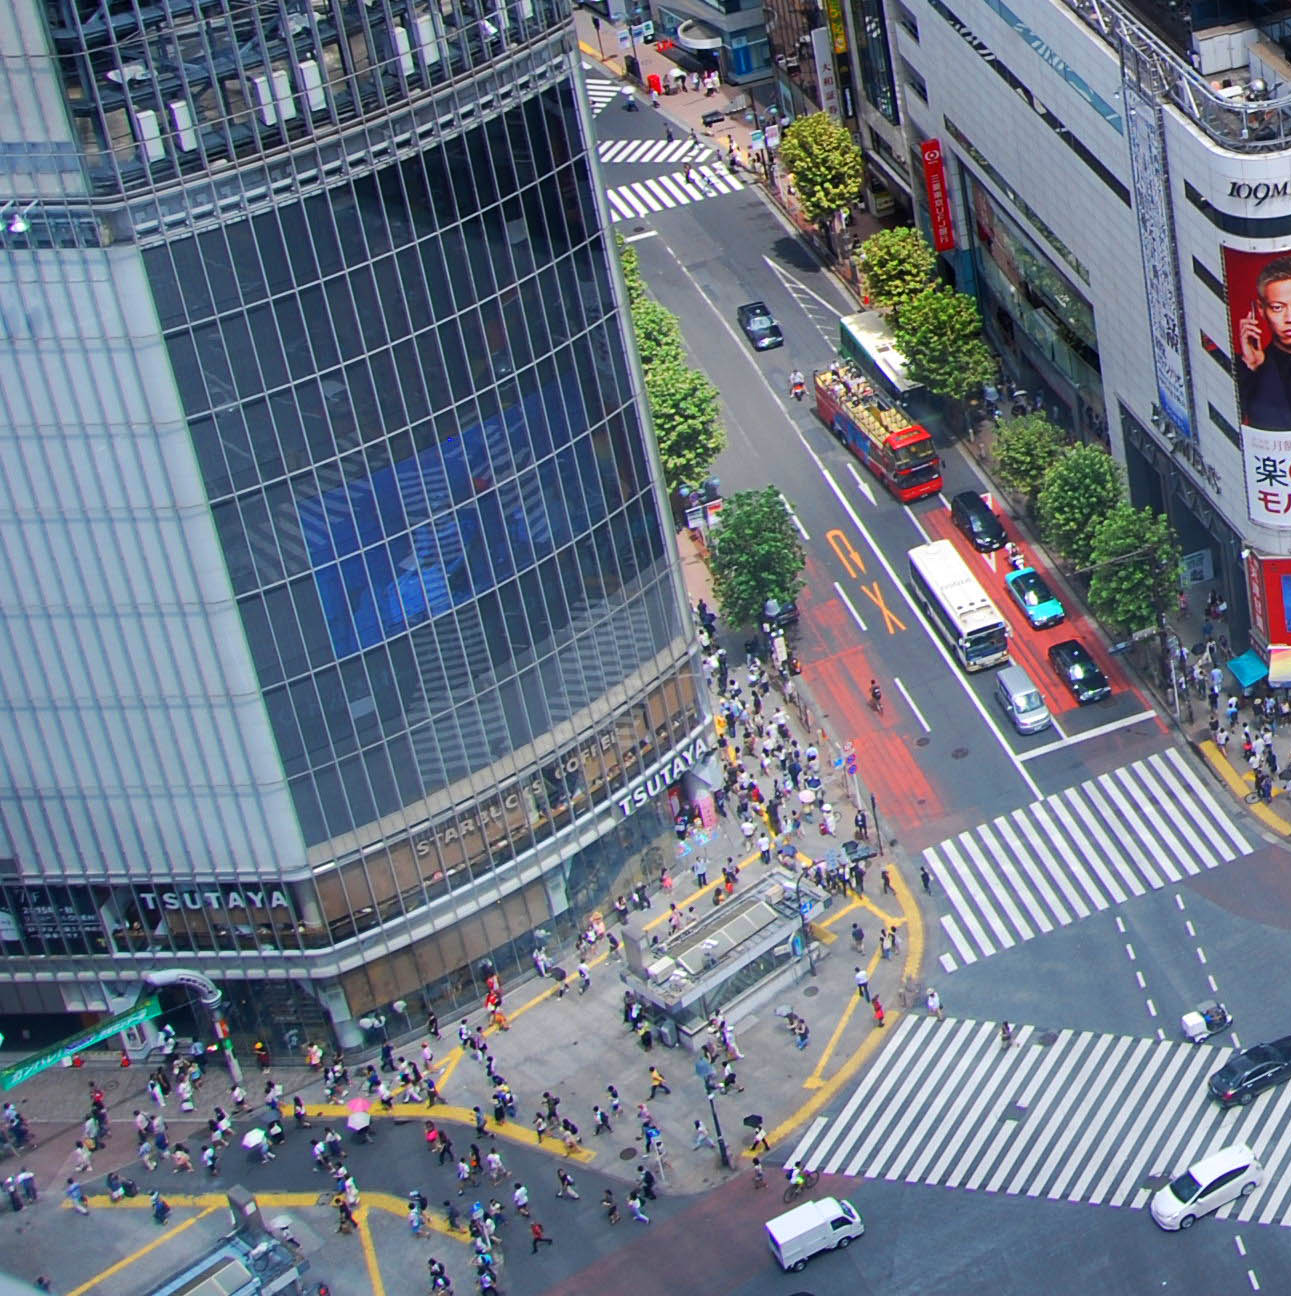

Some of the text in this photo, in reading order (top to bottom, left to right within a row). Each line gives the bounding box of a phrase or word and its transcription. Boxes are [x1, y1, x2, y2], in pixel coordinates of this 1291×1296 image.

[416, 778, 544, 857] STARBUCKS
[616, 737, 710, 819] TSUTAYA
[139, 889, 289, 911] TSUTAYA
